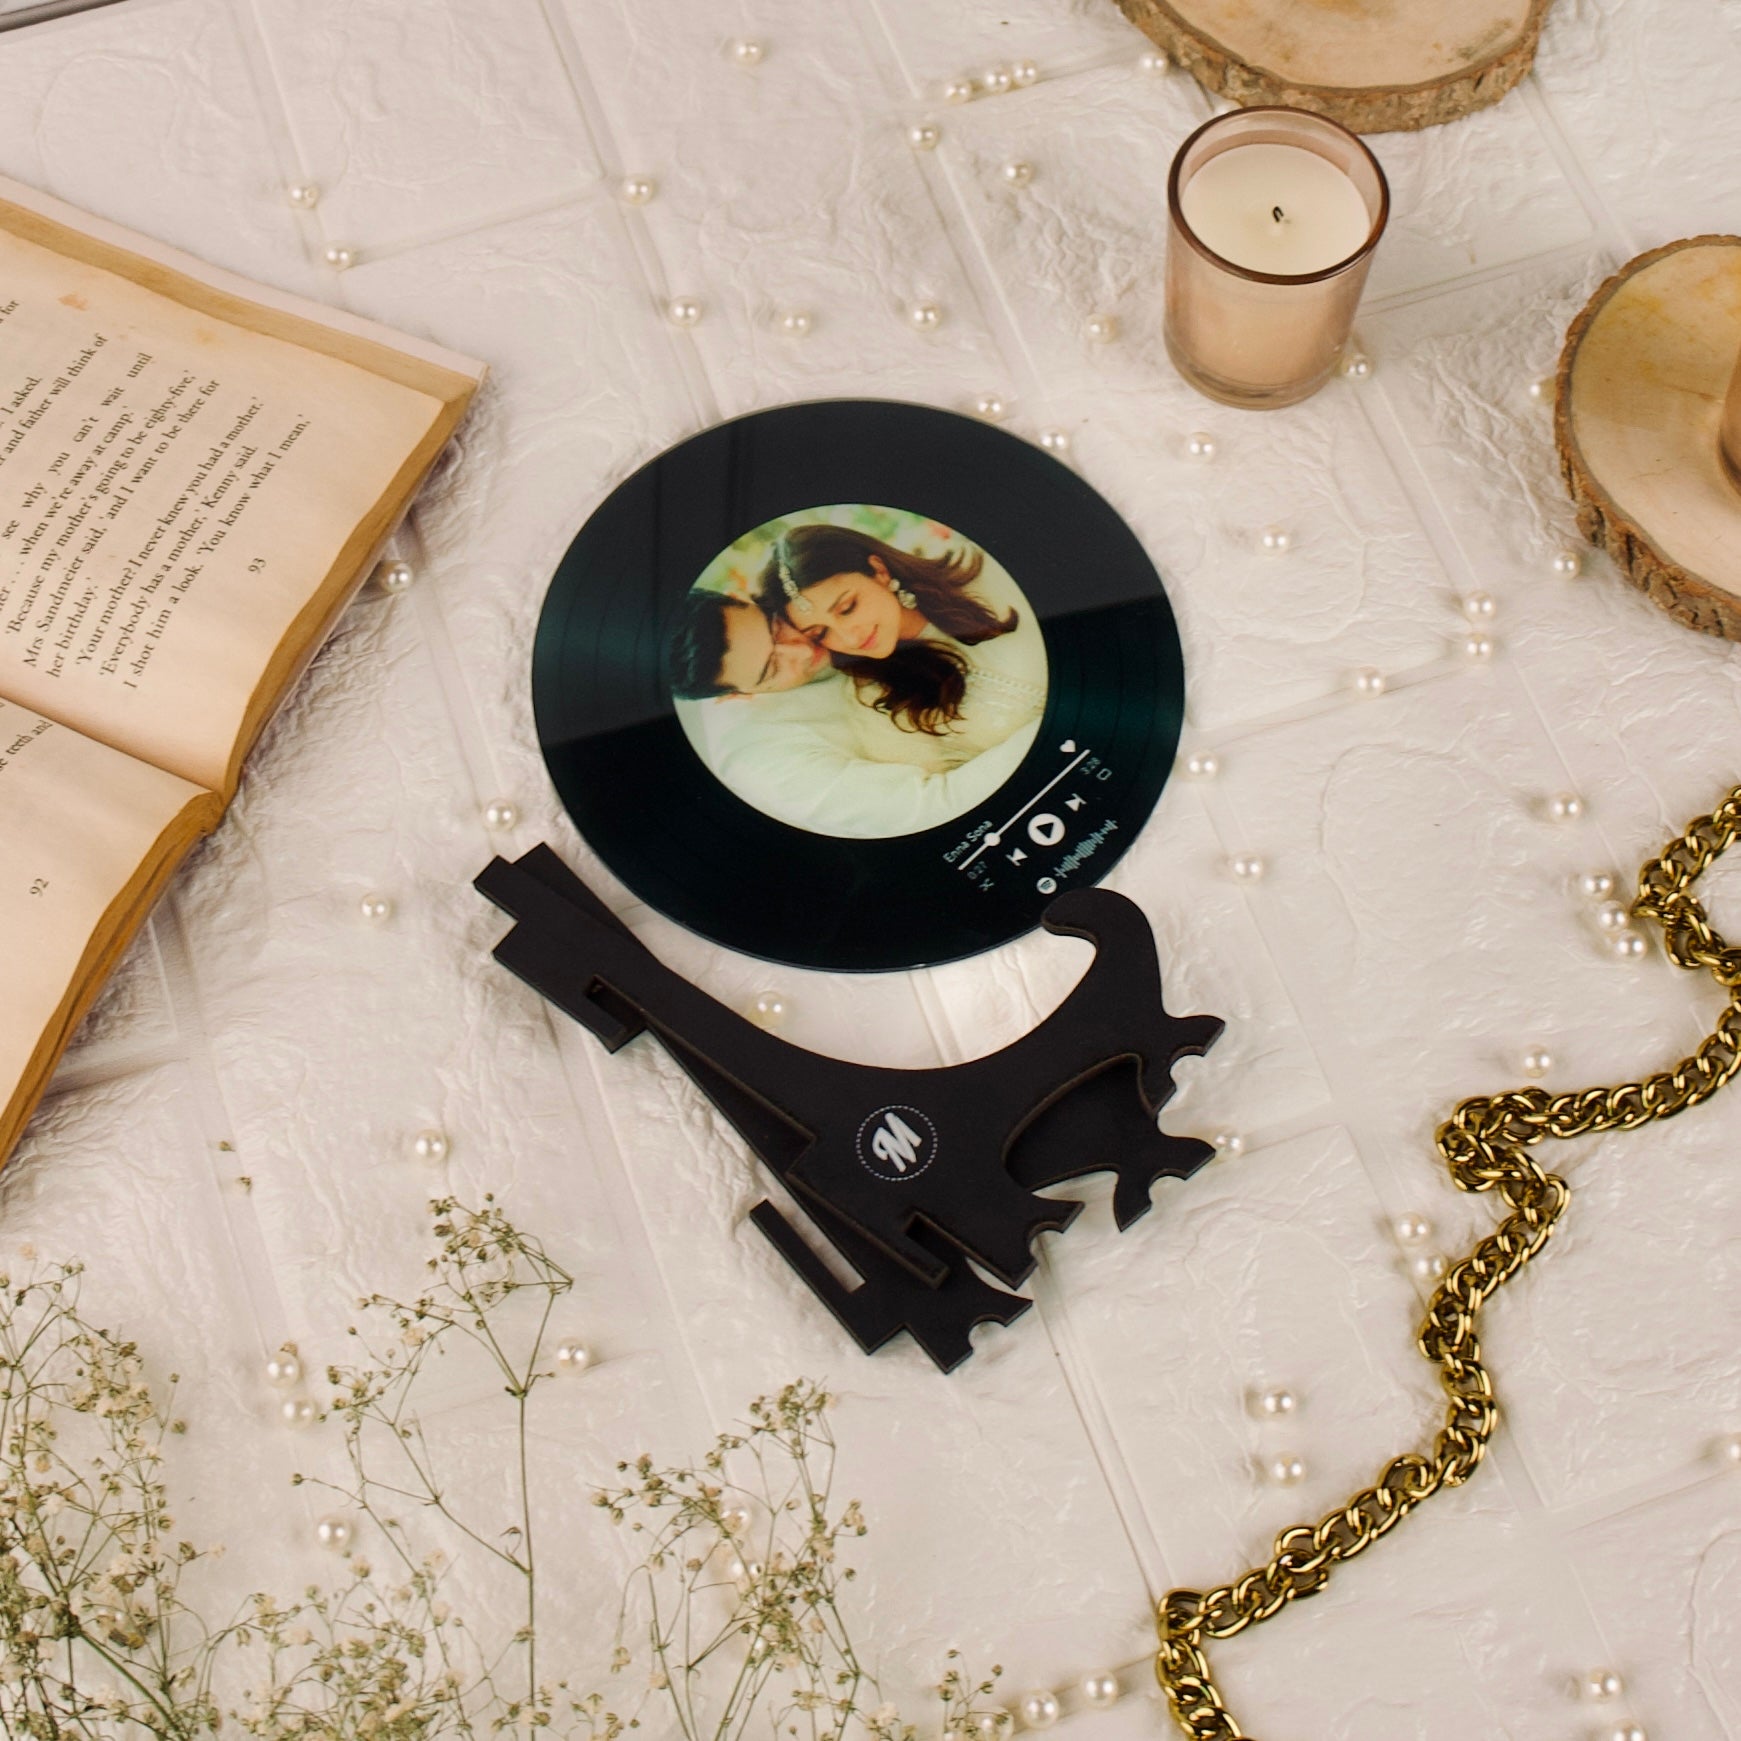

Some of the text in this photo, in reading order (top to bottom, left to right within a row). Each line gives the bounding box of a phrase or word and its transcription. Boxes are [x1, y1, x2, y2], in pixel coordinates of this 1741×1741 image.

[0, 377, 42, 415] I asked.
[3, 332, 109, 454] and father will think of
[199, 380, 220, 396] for
[177, 398, 205, 423] there
[126, 431, 148, 445] be
[161, 424, 182, 439] be
[1, 352, 153, 540] see why you can't wait until
[120, 446, 135, 459] to
[154, 441, 169, 454] to
[268, 452, 282, 460] I
[95, 459, 128, 495] going
[131, 456, 158, 483] want
[249, 461, 275, 489] what
[19, 522, 49, 555] when
[44, 487, 73, 518] we're
[69, 456, 98, 486] away
[93, 444, 107, 456] at
[120, 486, 135, 494] I
[56, 494, 98, 547] mother's
[139, 573, 165, 594] has
[161, 563, 173, 572] a
[201, 469, 240, 509] Kenny
[234, 445, 258, 470] said.
[218, 493, 251, 527] know
[100, 567, 137, 625] mother?
[128, 559, 143, 567] I
[138, 526, 166, 560] never
[156, 494, 188, 525] knew
[185, 472, 208, 496] you
[197, 447, 224, 471] had
[220, 440, 231, 449] a
[40, 549, 62, 571] my
[248, 557, 267, 574] 93
[171, 564, 204, 593] look.
[36, 556, 84, 632] Sandmeier
[169, 596, 181, 605] a
[145, 608, 172, 640] him
[23, 637, 44, 667] Mrs
[46, 652, 65, 678] her
[131, 643, 155, 677] shot
[122, 680, 138, 689] I
[5, 719, 53, 755] teeth and
[942, 820, 994, 863] Enna Sona
[29, 878, 50, 898] 92
